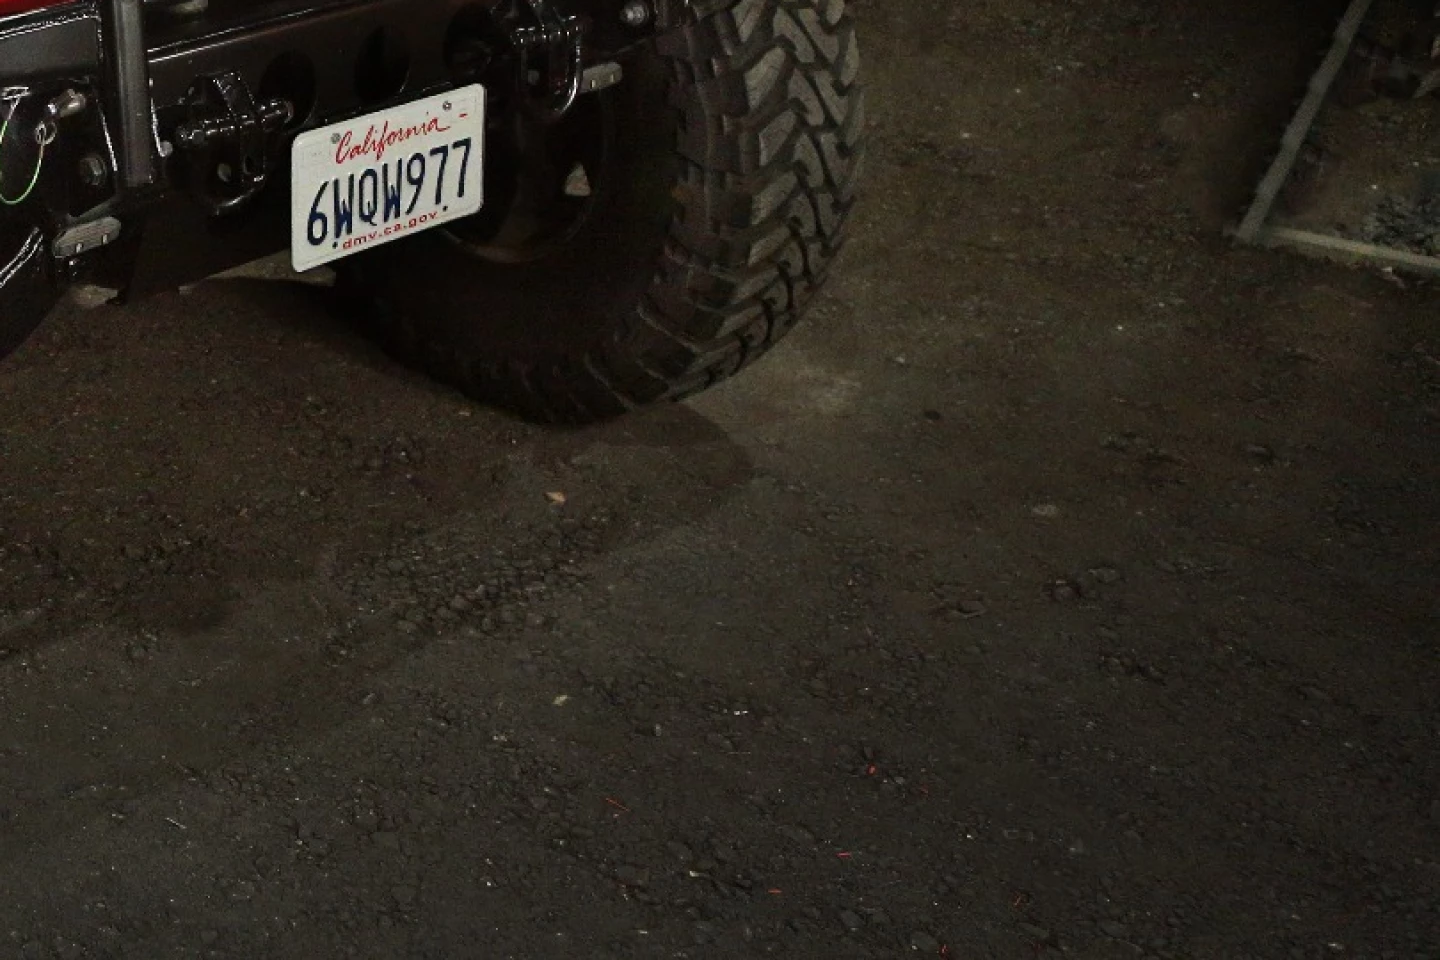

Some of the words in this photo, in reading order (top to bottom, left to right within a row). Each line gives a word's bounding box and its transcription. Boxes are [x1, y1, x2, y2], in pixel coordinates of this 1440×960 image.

[335, 113, 451, 164] California
[307, 137, 472, 246] 6WQW977
[342, 211, 438, 249] dmv.ca.gov
